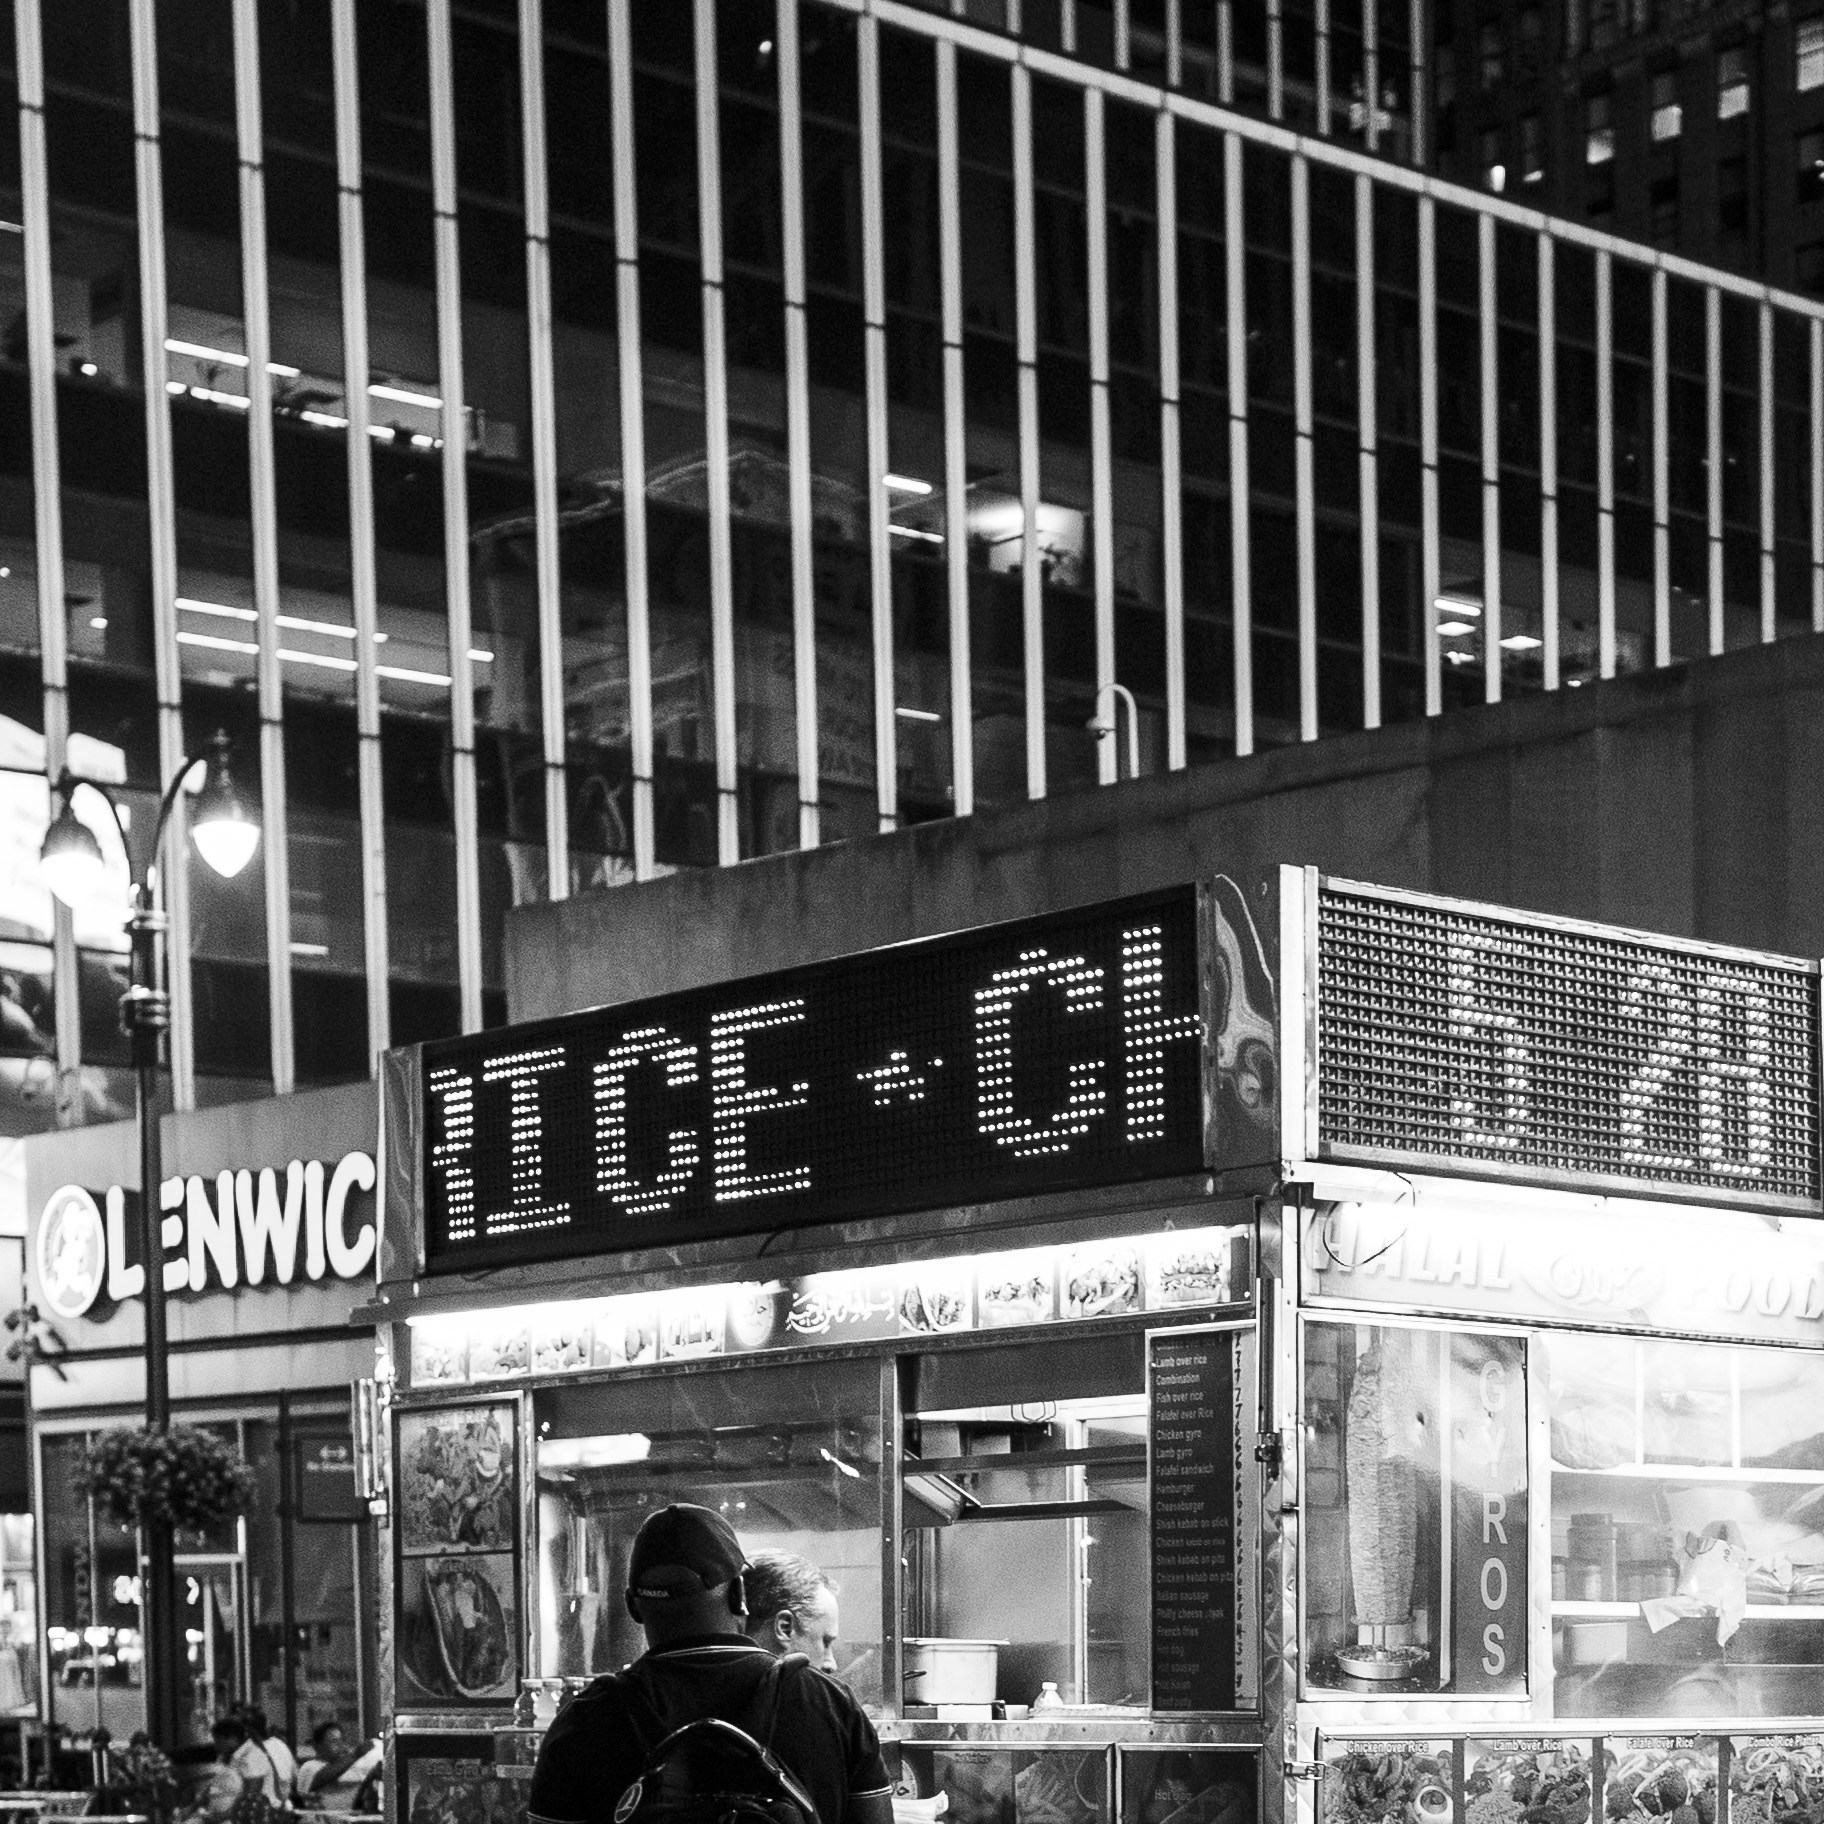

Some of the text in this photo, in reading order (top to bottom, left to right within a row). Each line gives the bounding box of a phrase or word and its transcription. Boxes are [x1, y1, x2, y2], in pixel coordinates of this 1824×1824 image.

[1313, 1206, 1513, 1291] HALAL
[1478, 1359, 1509, 1676] GYROS
[1347, 1740, 1429, 1753] Chicken over Rice
[1493, 1738, 1564, 1751] Lamb over Rice
[1675, 1737, 1694, 1749] Rice
